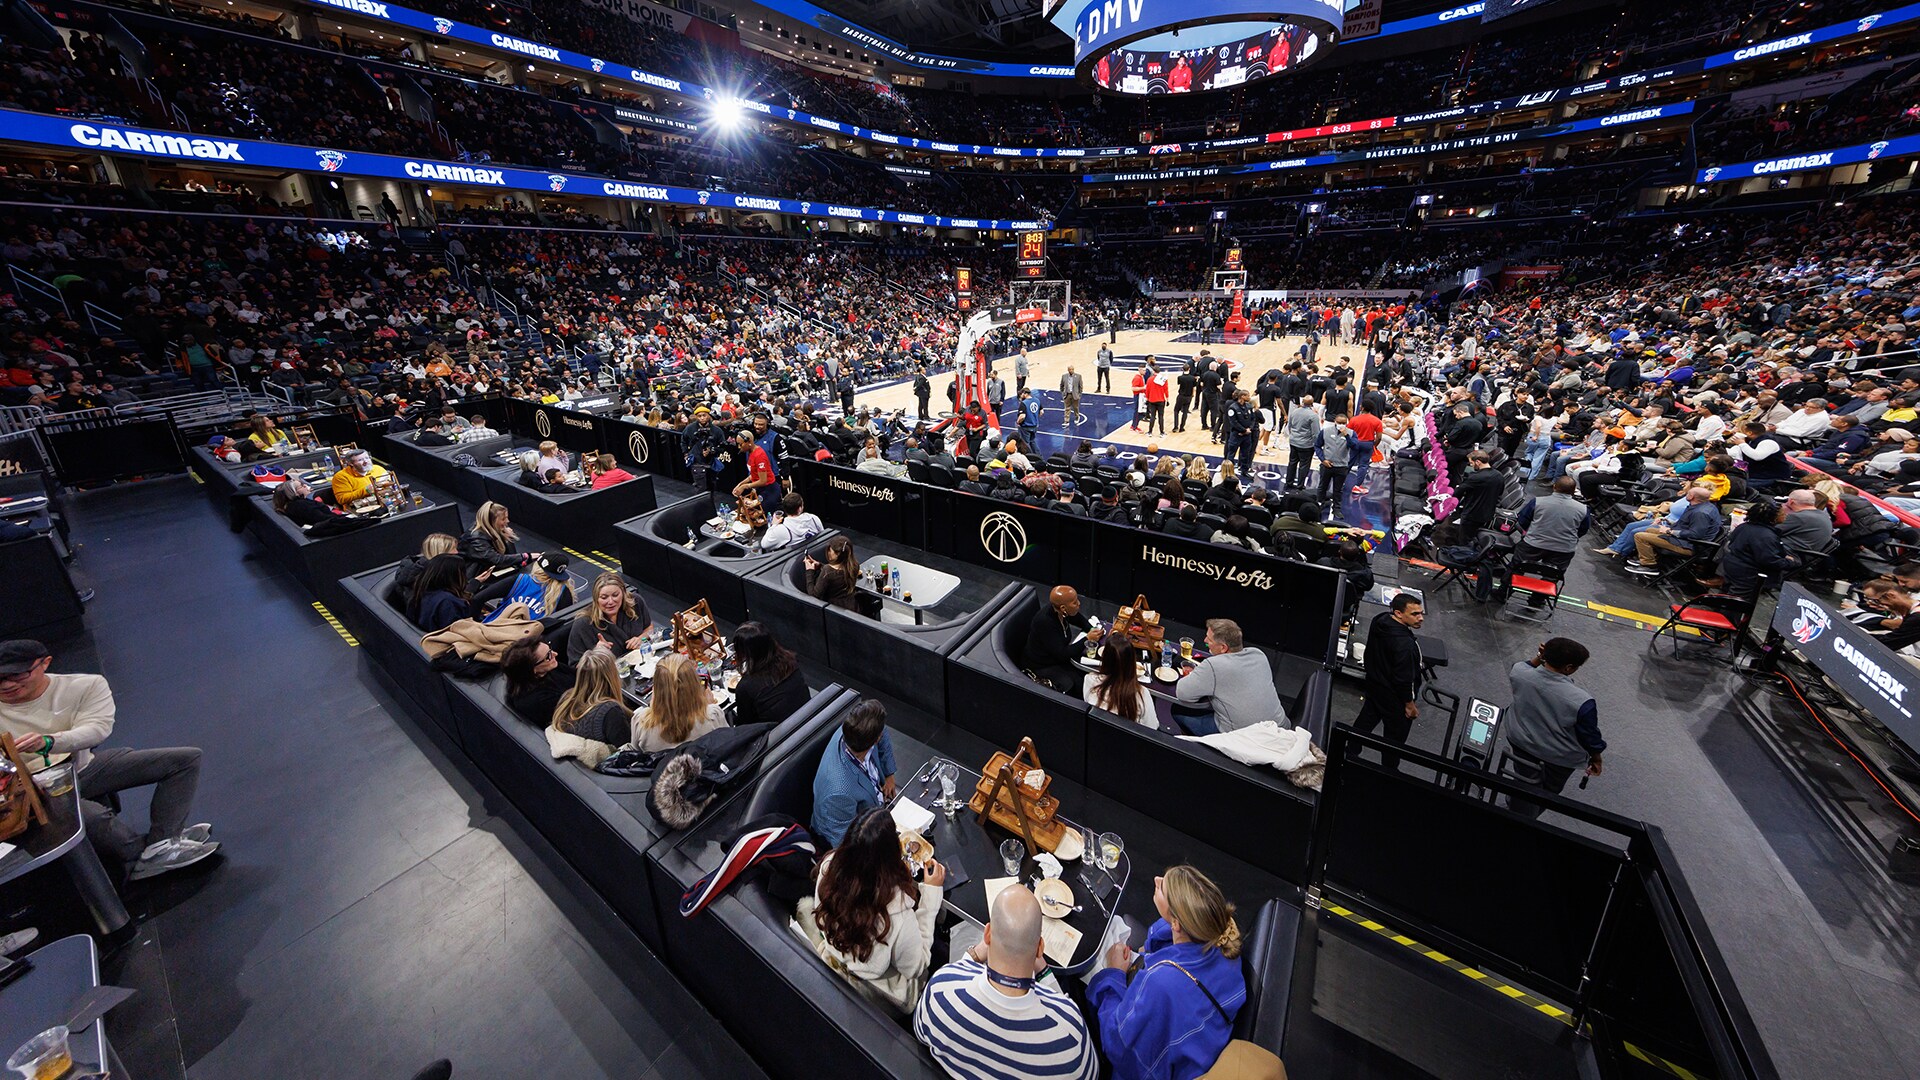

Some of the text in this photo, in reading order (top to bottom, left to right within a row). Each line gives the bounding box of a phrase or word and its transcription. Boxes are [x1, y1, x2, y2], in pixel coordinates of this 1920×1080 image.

[628, 0, 674, 29] HOME
[1438, 2, 1486, 21] CAR
[1088, 0, 1144, 44] DMV
[1343, 20, 1376, 35] 1977-78
[842, 26, 890, 51] BASKETBALL
[891, 47, 906, 58] DAY
[918, 57, 934, 66] THE
[938, 60, 957, 68] DMV
[1029, 66, 1076, 76] CARma
[1403, 108, 1465, 123] SAN ANTONIO
[1282, 132, 1293, 141] 78
[1332, 124, 1351, 134] 8:03
[1369, 120, 1382, 129] 83
[70, 124, 245, 161] CARmax
[1212, 137, 1259, 147] WASHINGTON
[1366, 133, 1519, 159] BASKETBALL DAY IN THE DMV
[404, 161, 506, 185] CARmax
[1114, 172, 1157, 181] BASKETBALL
[1160, 172, 1174, 180] DAY
[1204, 168, 1219, 176] DMV
[603, 182, 669, 201] CARmax
[1025, 232, 1043, 243] 8:03
[1023, 243, 1041, 259] 24
[779, 439, 787, 450] 5
[829, 475, 896, 502] Hennessy Lofts
[1142, 544, 1275, 591] Hennessy Lofts
[511, 595, 545, 615] ARENAS
[1796, 598, 1832, 630] BASKETBALL
[1833, 636, 1905, 702] CARmax
